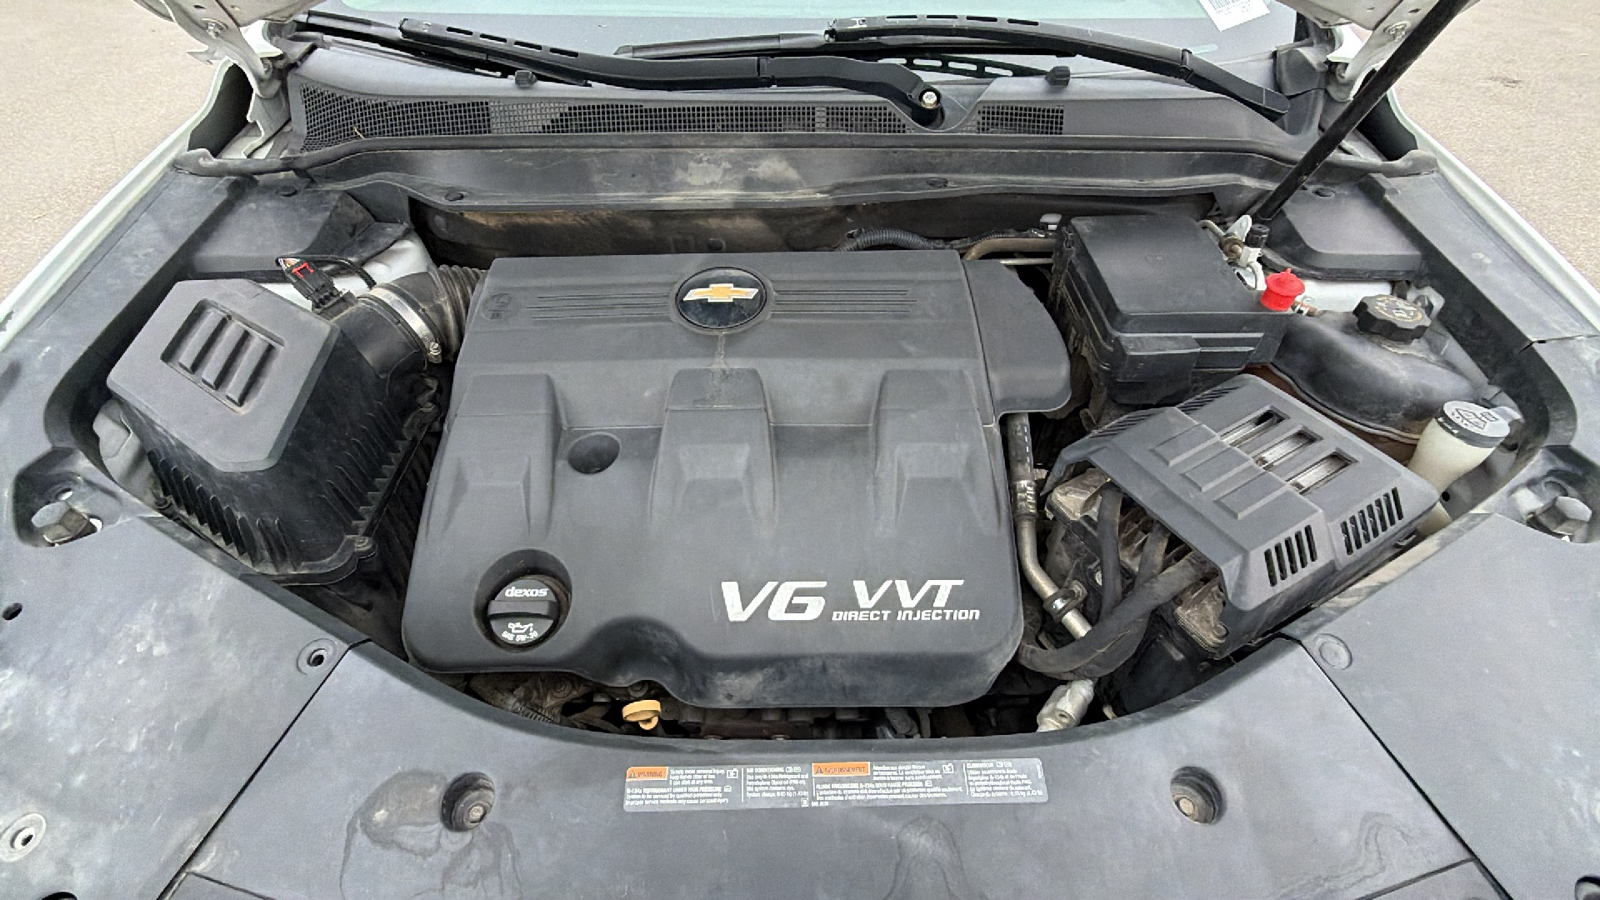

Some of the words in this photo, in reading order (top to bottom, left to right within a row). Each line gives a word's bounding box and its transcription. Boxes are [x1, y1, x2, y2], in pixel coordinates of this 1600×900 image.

[505, 587, 549, 597] dexos
[721, 581, 828, 622] V6
[853, 580, 965, 608] VVT
[832, 610, 891, 621] DIRECT
[897, 609, 980, 621] INJECTION
[501, 631, 515, 641] SAE
